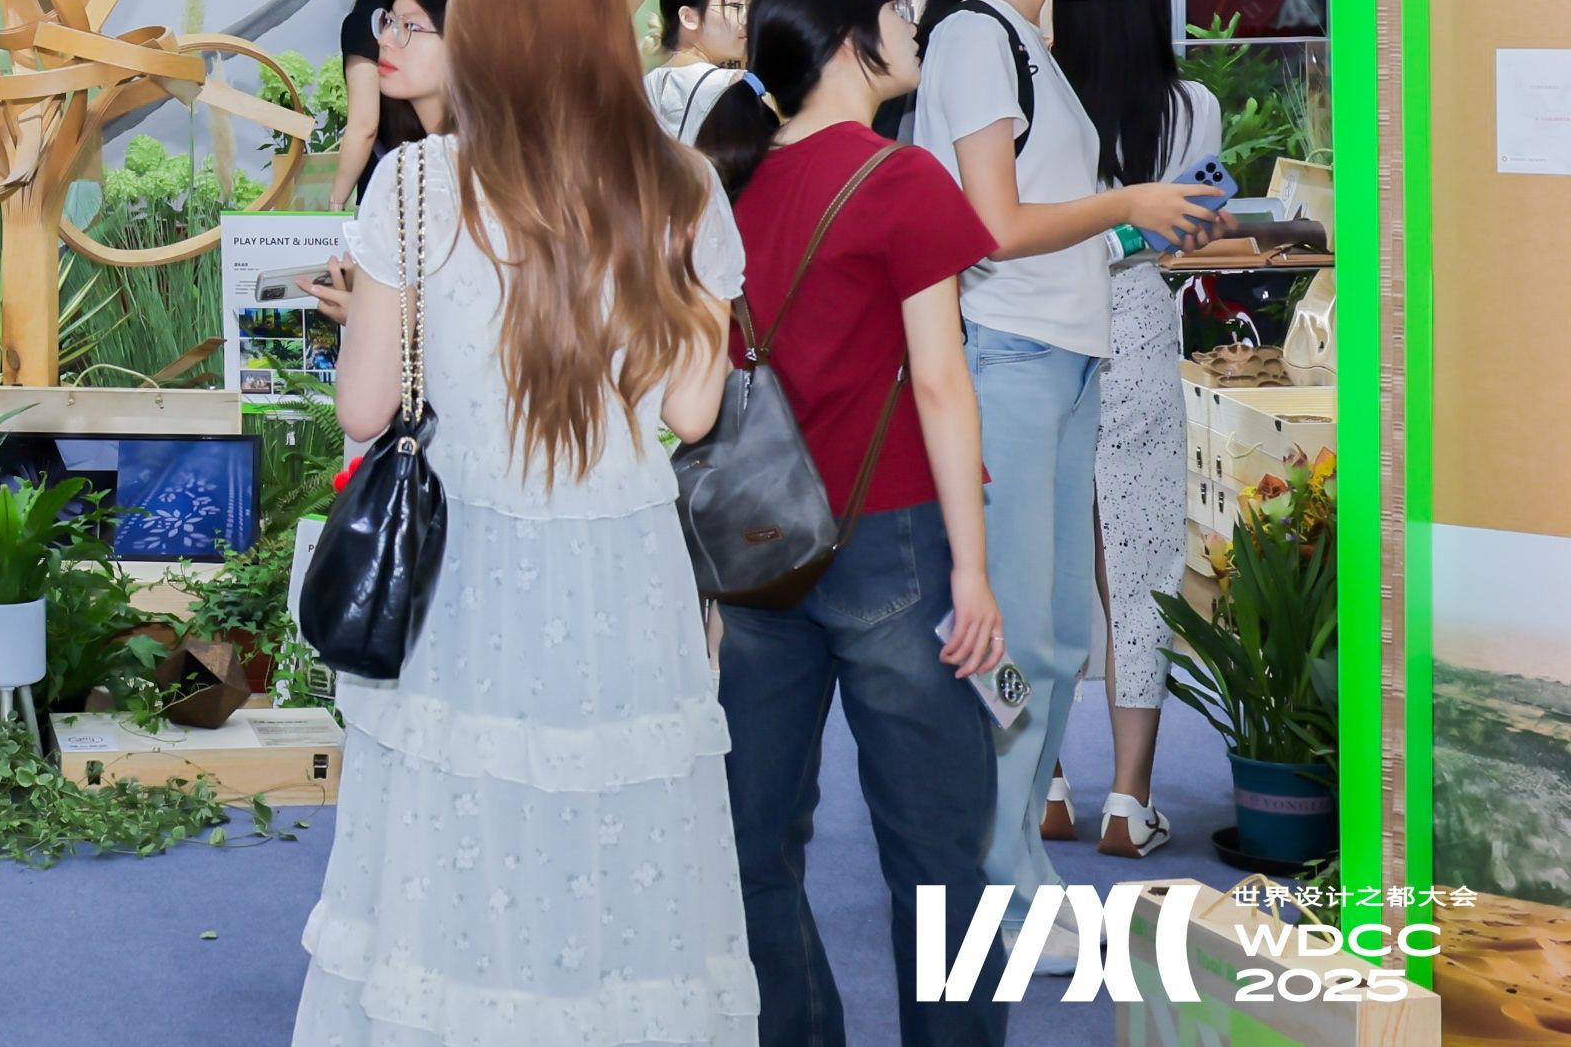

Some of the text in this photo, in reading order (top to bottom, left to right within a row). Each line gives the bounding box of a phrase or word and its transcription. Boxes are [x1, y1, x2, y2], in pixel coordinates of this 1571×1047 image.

[233, 237, 340, 246] PLAY PLANT & JUNGLE
